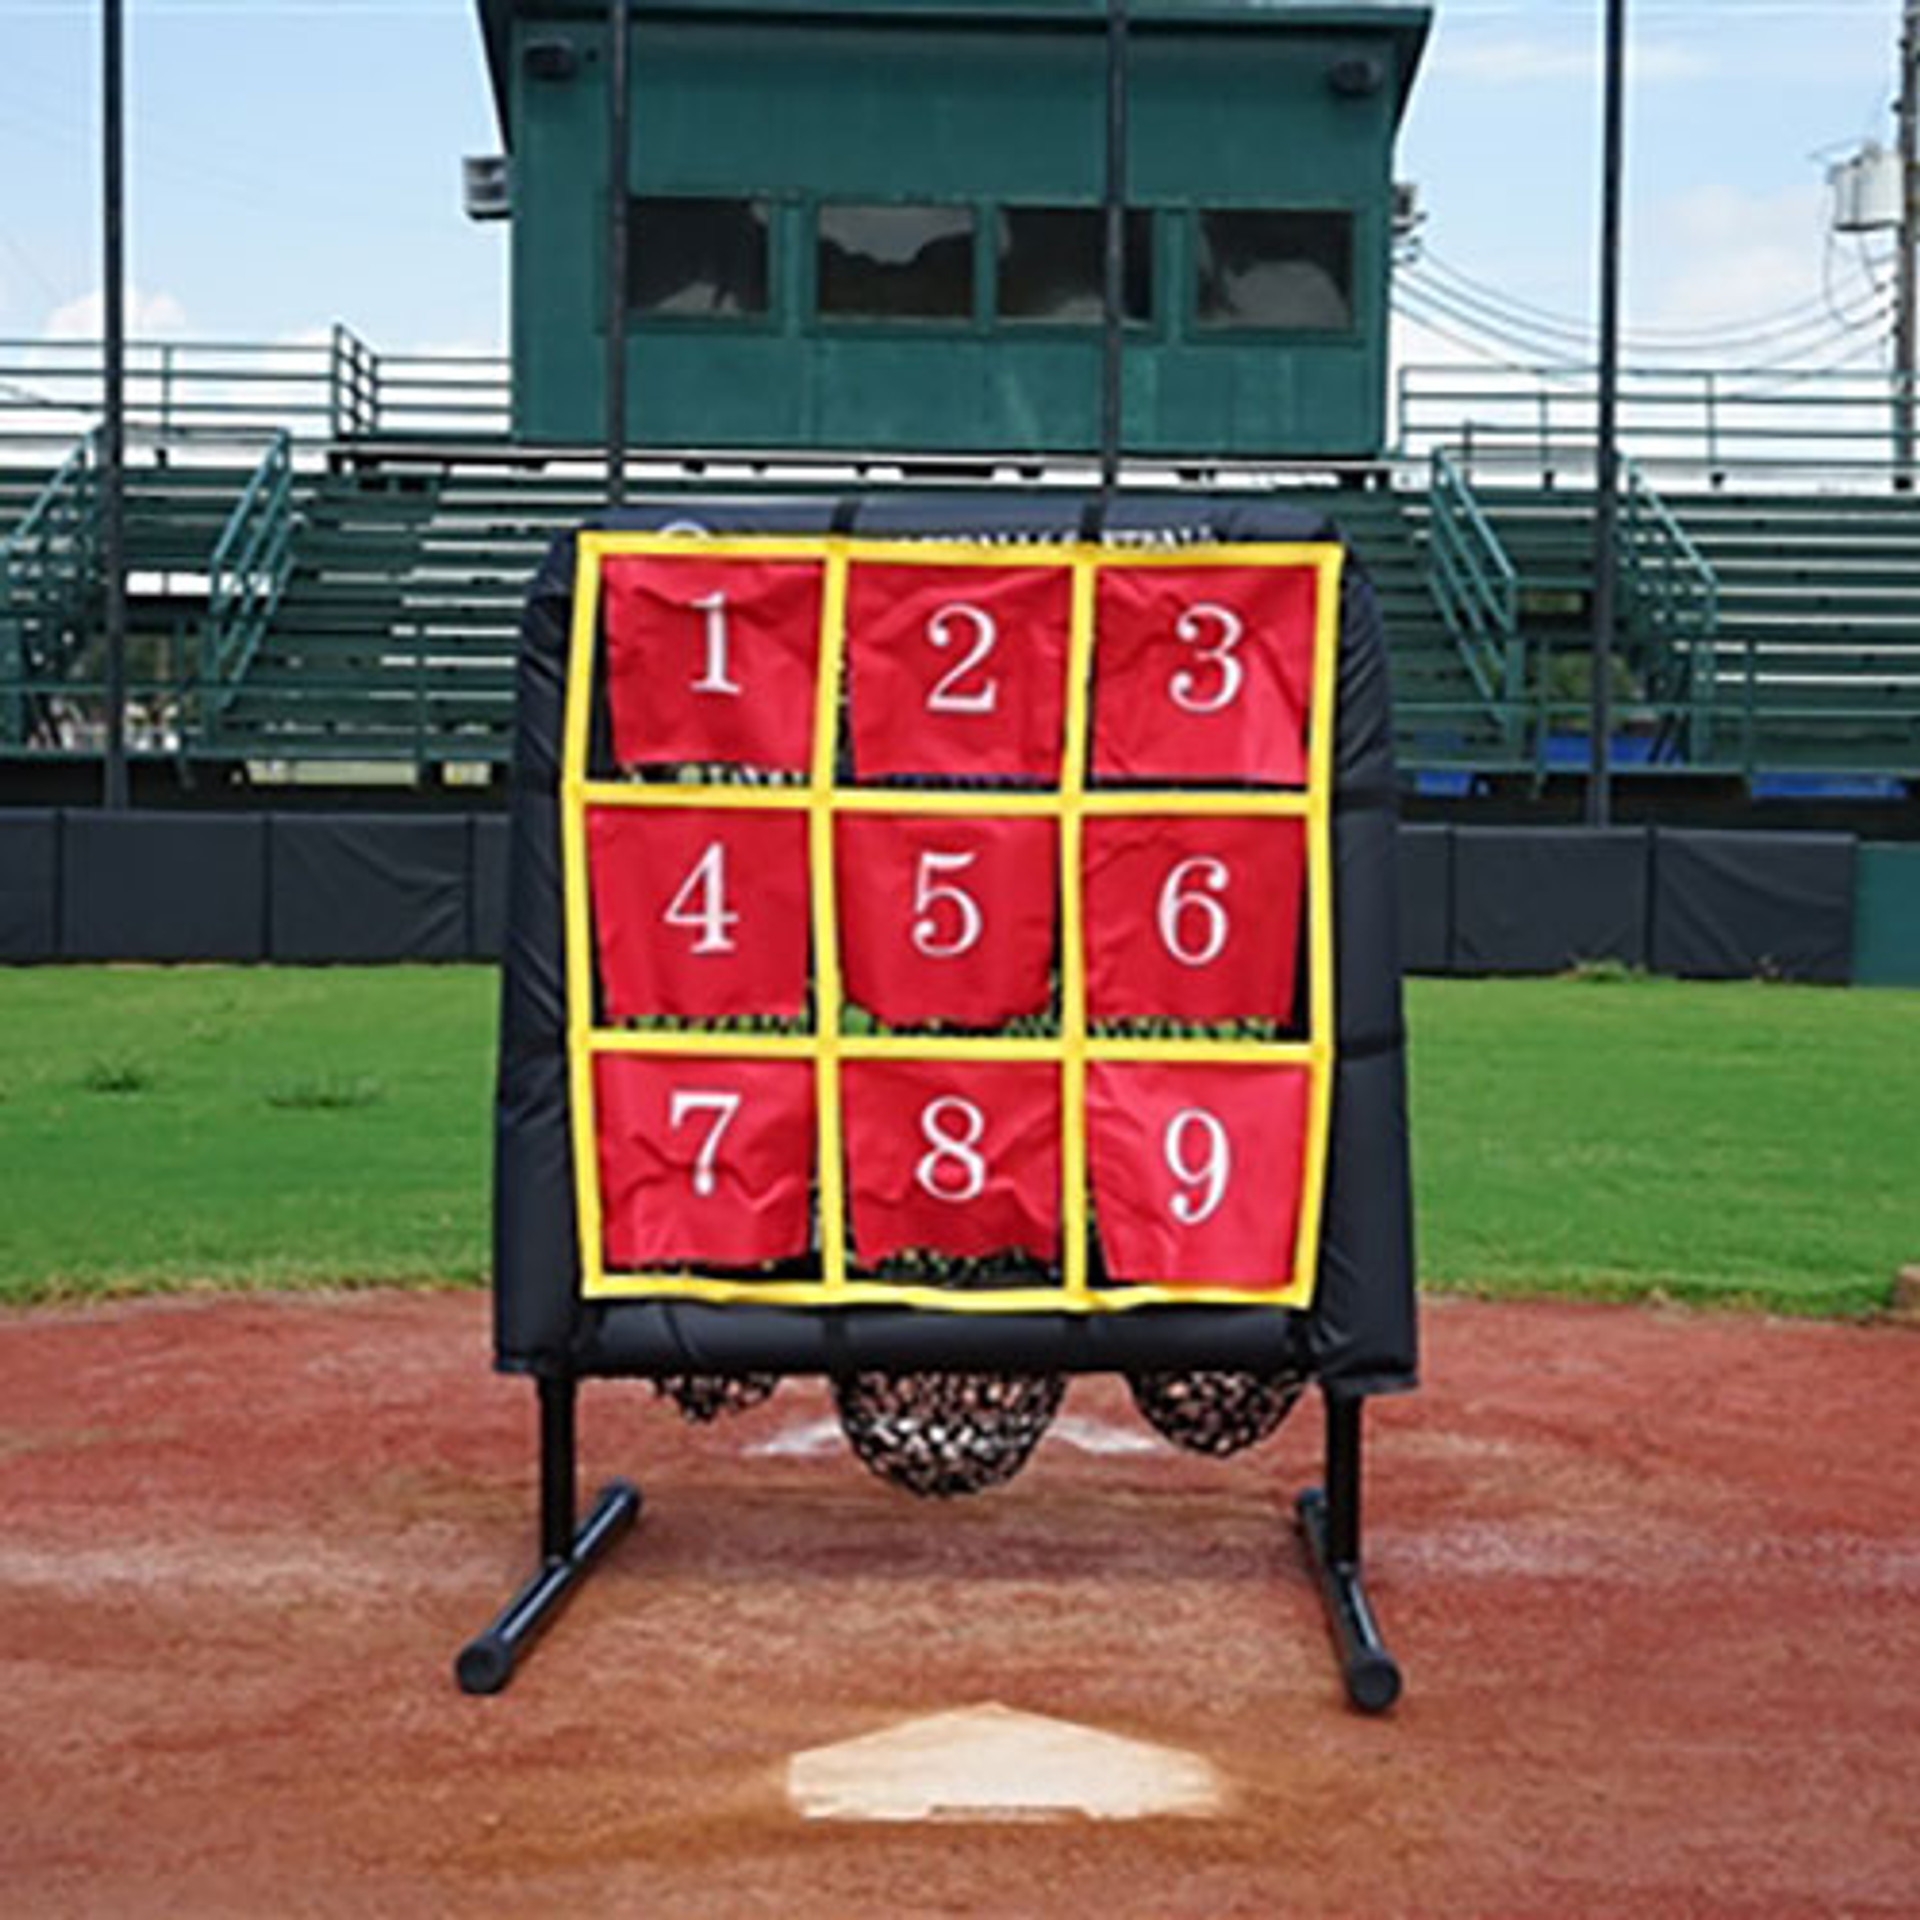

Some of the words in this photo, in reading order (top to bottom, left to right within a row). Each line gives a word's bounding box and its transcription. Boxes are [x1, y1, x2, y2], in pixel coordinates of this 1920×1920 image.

[690, 591, 744, 696] 1
[928, 604, 996, 713] 2
[1169, 604, 1243, 712] 3
[663, 842, 740, 955] 4
[912, 851, 983, 957] 5
[1158, 857, 1229, 966] 6
[670, 1090, 741, 1197] 7
[915, 1097, 986, 1202] 8
[1163, 1109, 1231, 1225] 9
